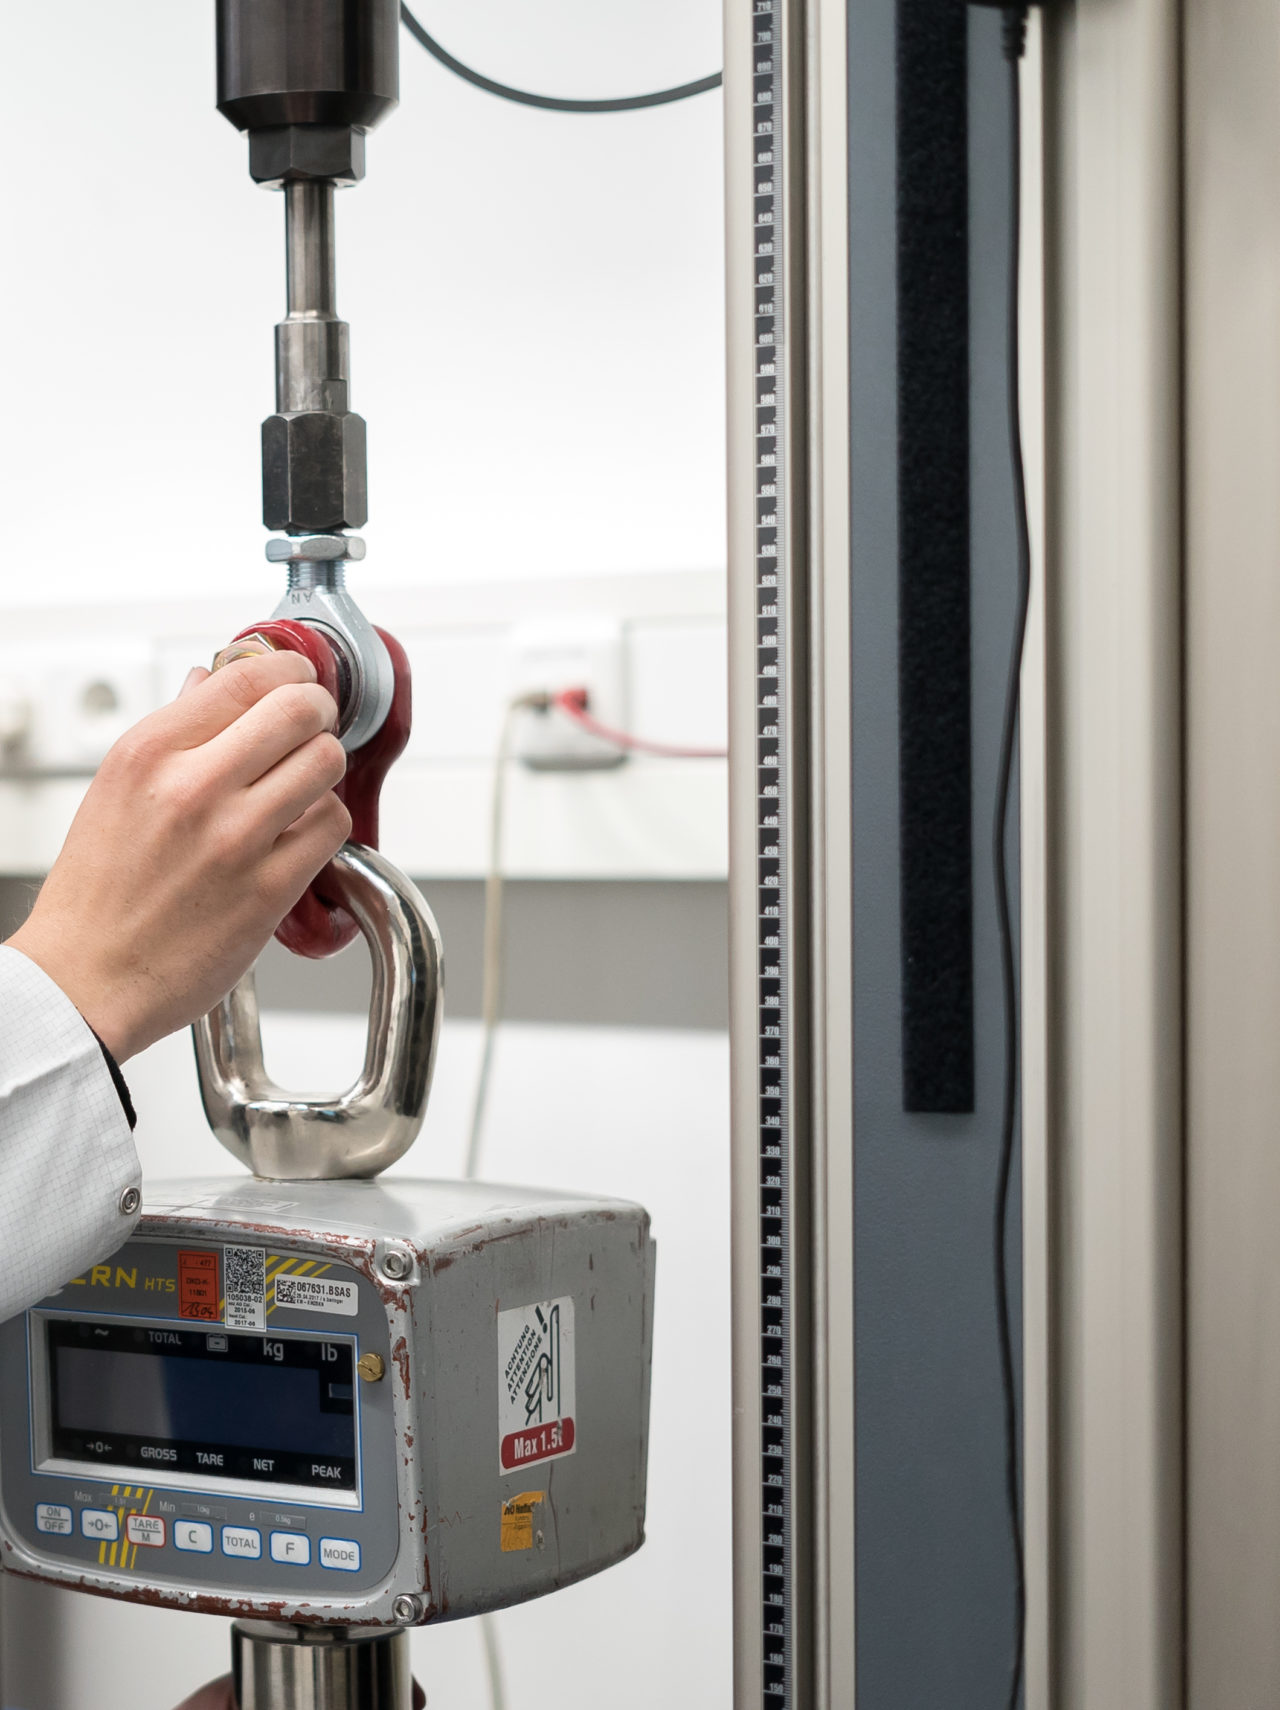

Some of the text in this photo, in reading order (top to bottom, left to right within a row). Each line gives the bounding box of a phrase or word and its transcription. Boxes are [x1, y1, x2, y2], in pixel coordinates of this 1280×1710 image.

[761, 484, 776, 495] 550
[761, 514, 776, 525] 540
[761, 544, 776, 556] 530
[761, 574, 777, 586] 520
[762, 605, 777, 616] 510
[762, 635, 777, 646] 500
[762, 665, 777, 676] 490
[763, 725, 778, 737] 470
[763, 755, 778, 767] 460
[763, 785, 778, 797] 450
[764, 815, 779, 827] 440
[764, 846, 779, 857] 430
[764, 876, 779, 887] 420
[764, 906, 779, 917] 410
[764, 936, 780, 947] 400
[765, 966, 780, 978] 390
[765, 996, 780, 1008] 380
[765, 1026, 780, 1038] 370
[765, 1056, 780, 1068] 360
[765, 1086, 780, 1098] 350
[765, 1116, 780, 1127] 340
[765, 1146, 781, 1157] 330
[766, 1175, 781, 1187] 320
[766, 1205, 781, 1217] 310
[766, 1235, 781, 1247] 300
[766, 1265, 781, 1277] 290
[144, 1277, 176, 1293] HTS
[296, 1281, 351, 1298] 067631.BSAS
[227, 1293, 263, 1304] 105038-02
[767, 1295, 782, 1307] 280
[767, 1325, 782, 1337] 270
[148, 1331, 182, 1345] TOTAL
[263, 1338, 284, 1361] kg
[321, 1343, 338, 1362] lb
[505, 1324, 530, 1379] ACHTUNG
[507, 1329, 536, 1392] ATTENTION
[767, 1355, 782, 1366] 260
[510, 1334, 542, 1405] ATTENZIONE
[767, 1385, 782, 1396] 250
[767, 1414, 783, 1426] 240
[140, 1446, 177, 1461] GROSS
[514, 1437, 538, 1460] Max
[768, 1444, 783, 1456] 230
[196, 1452, 224, 1466] TARE
[253, 1458, 275, 1471] NET
[312, 1464, 342, 1479] PEAK
[768, 1474, 783, 1486] 220
[46, 1506, 61, 1517] ON
[160, 1501, 176, 1512] Min
[768, 1504, 783, 1515] 210
[44, 1520, 65, 1531] OFF
[133, 1518, 159, 1530] TARE
[141, 1533, 151, 1542] M
[188, 1530, 197, 1544] C
[225, 1535, 257, 1550] TOTAL
[768, 1534, 783, 1545] 200
[285, 1542, 295, 1555] F
[323, 1548, 355, 1562] MODE
[768, 1564, 784, 1575] 190
[769, 1593, 784, 1605] 180
[769, 1623, 784, 1635] 170
[769, 1653, 784, 1664] 160
[769, 1683, 784, 1694] 150
